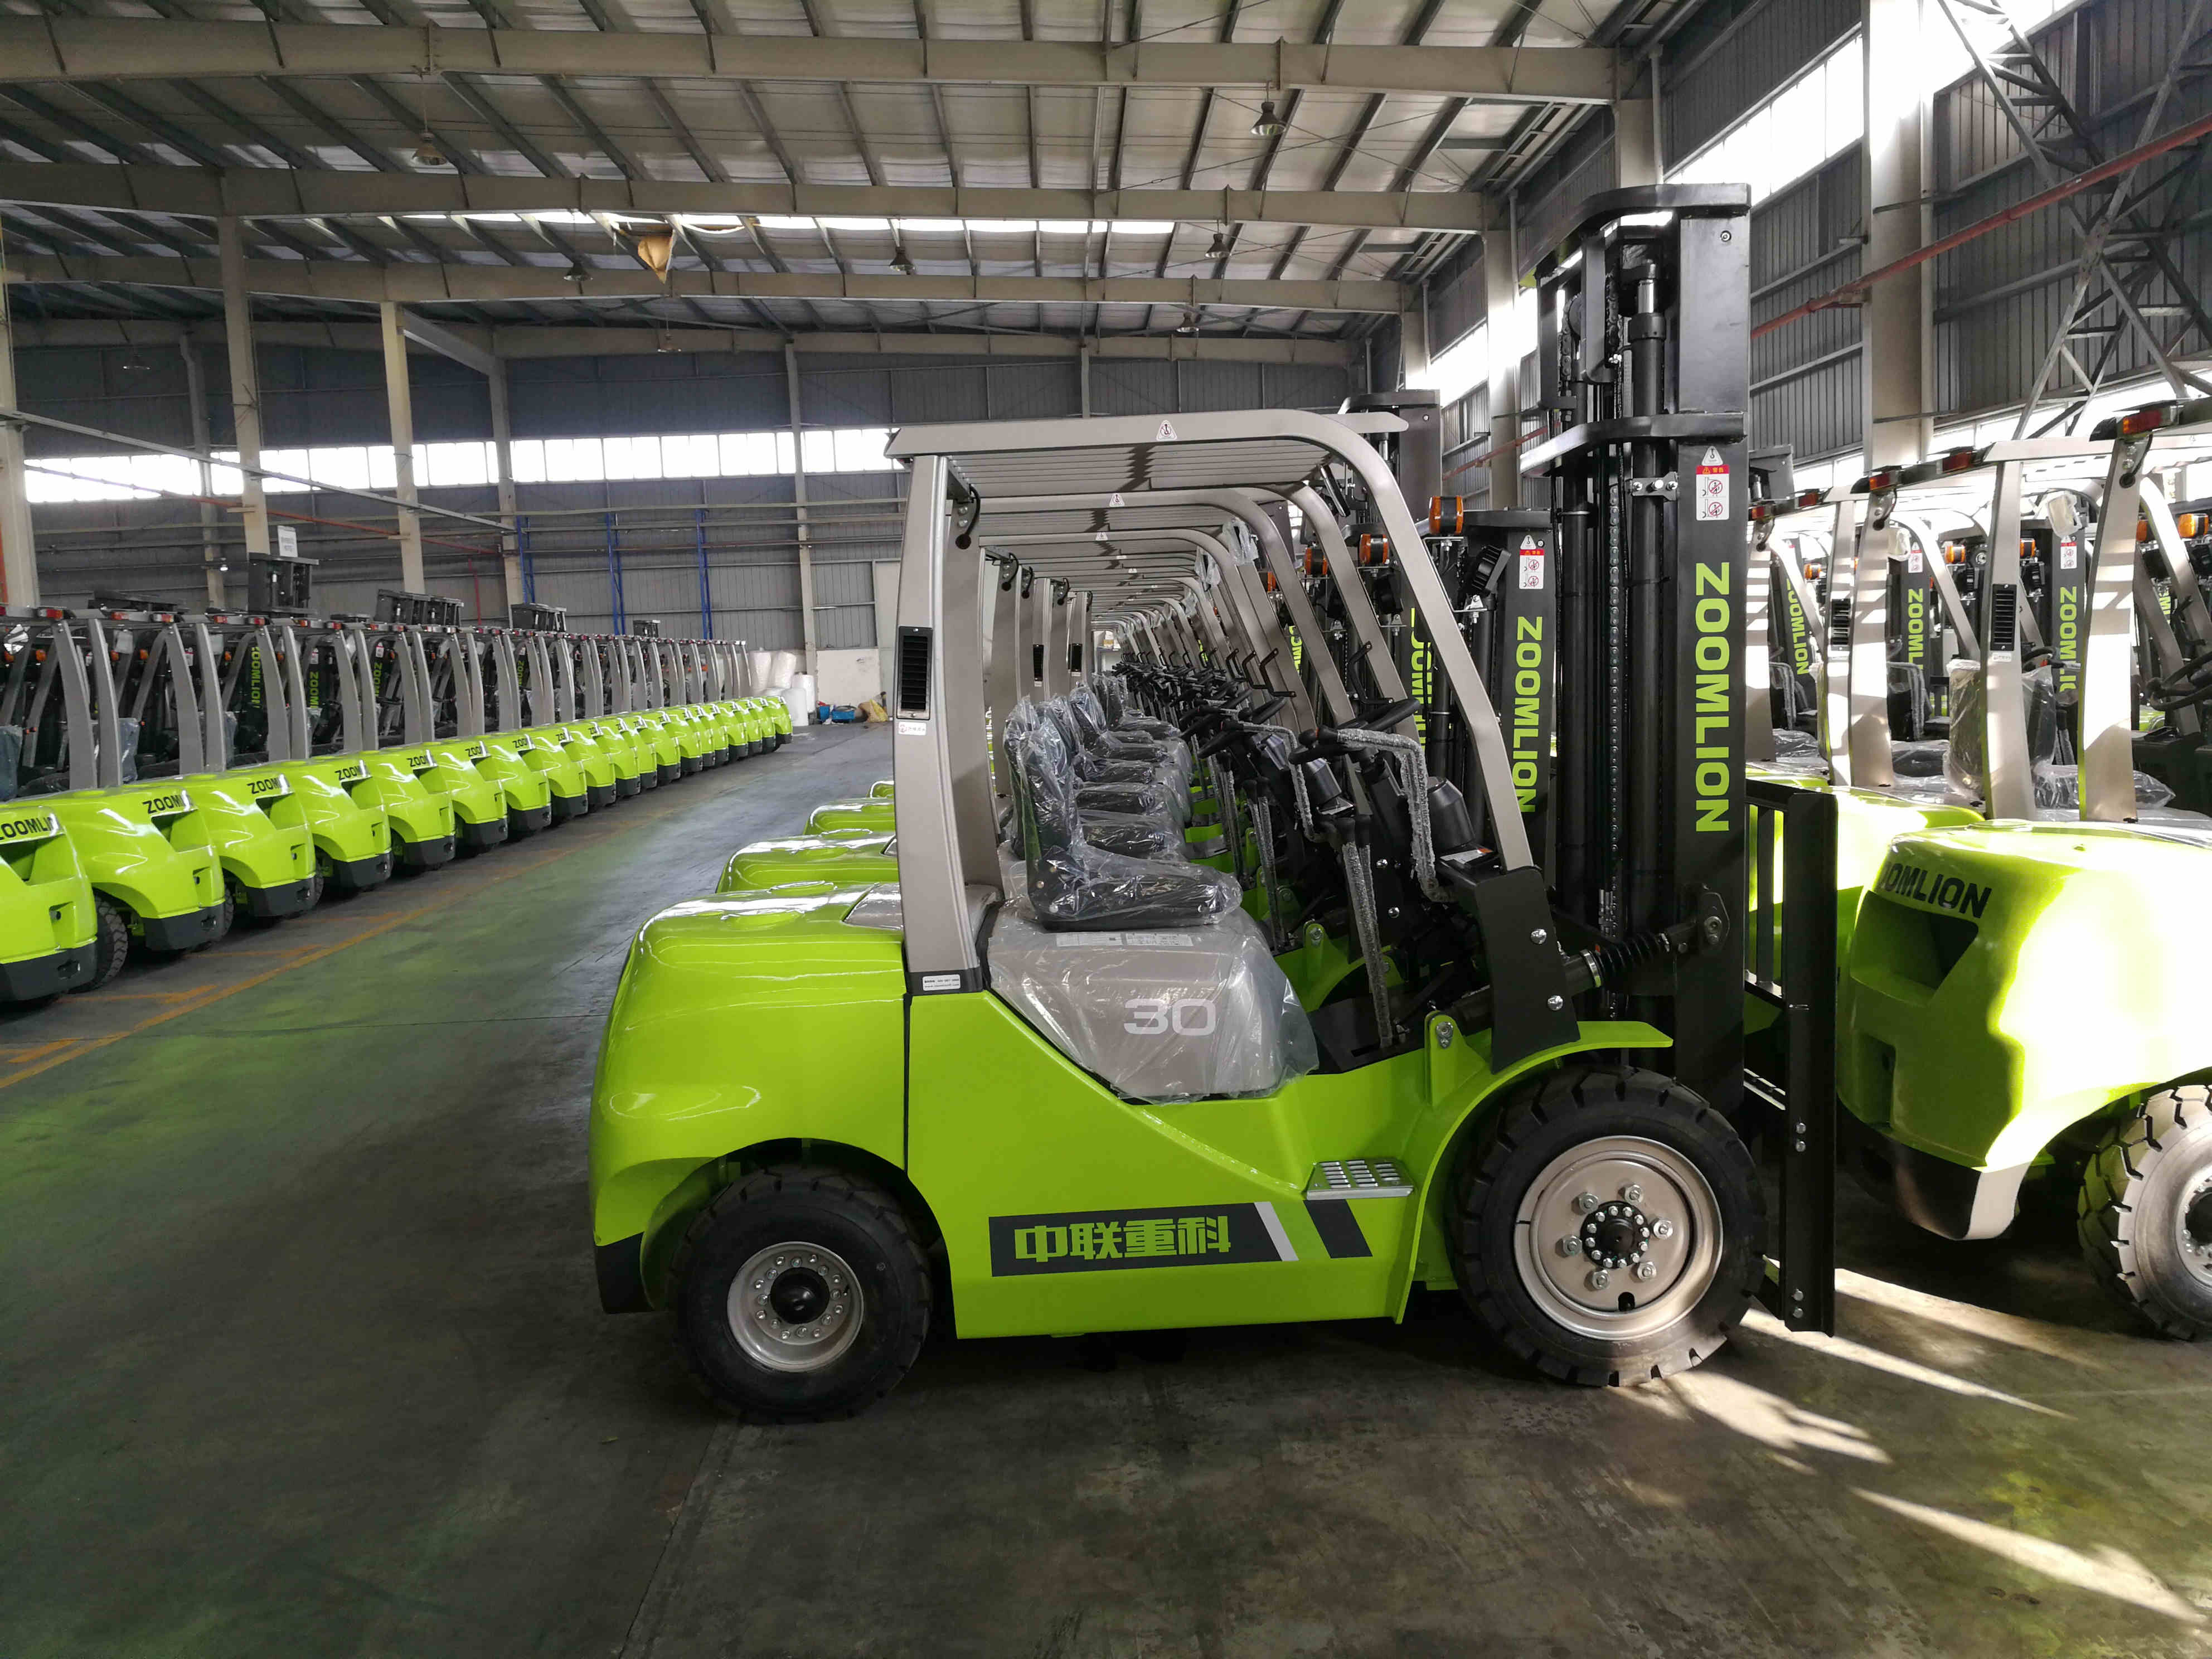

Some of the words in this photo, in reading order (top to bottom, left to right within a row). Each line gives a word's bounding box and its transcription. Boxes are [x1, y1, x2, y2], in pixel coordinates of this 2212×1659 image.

[1908, 588, 1924, 669] ZOOML
[309, 672, 319, 709] ZOOM
[1512, 616, 1542, 812] ZOOMLION
[1695, 562, 1730, 832] ZOOMLION
[0, 816, 54, 840] OOMLI
[1124, 998, 1216, 1036] 30
[1014, 1215, 1231, 1263] 中联重科
